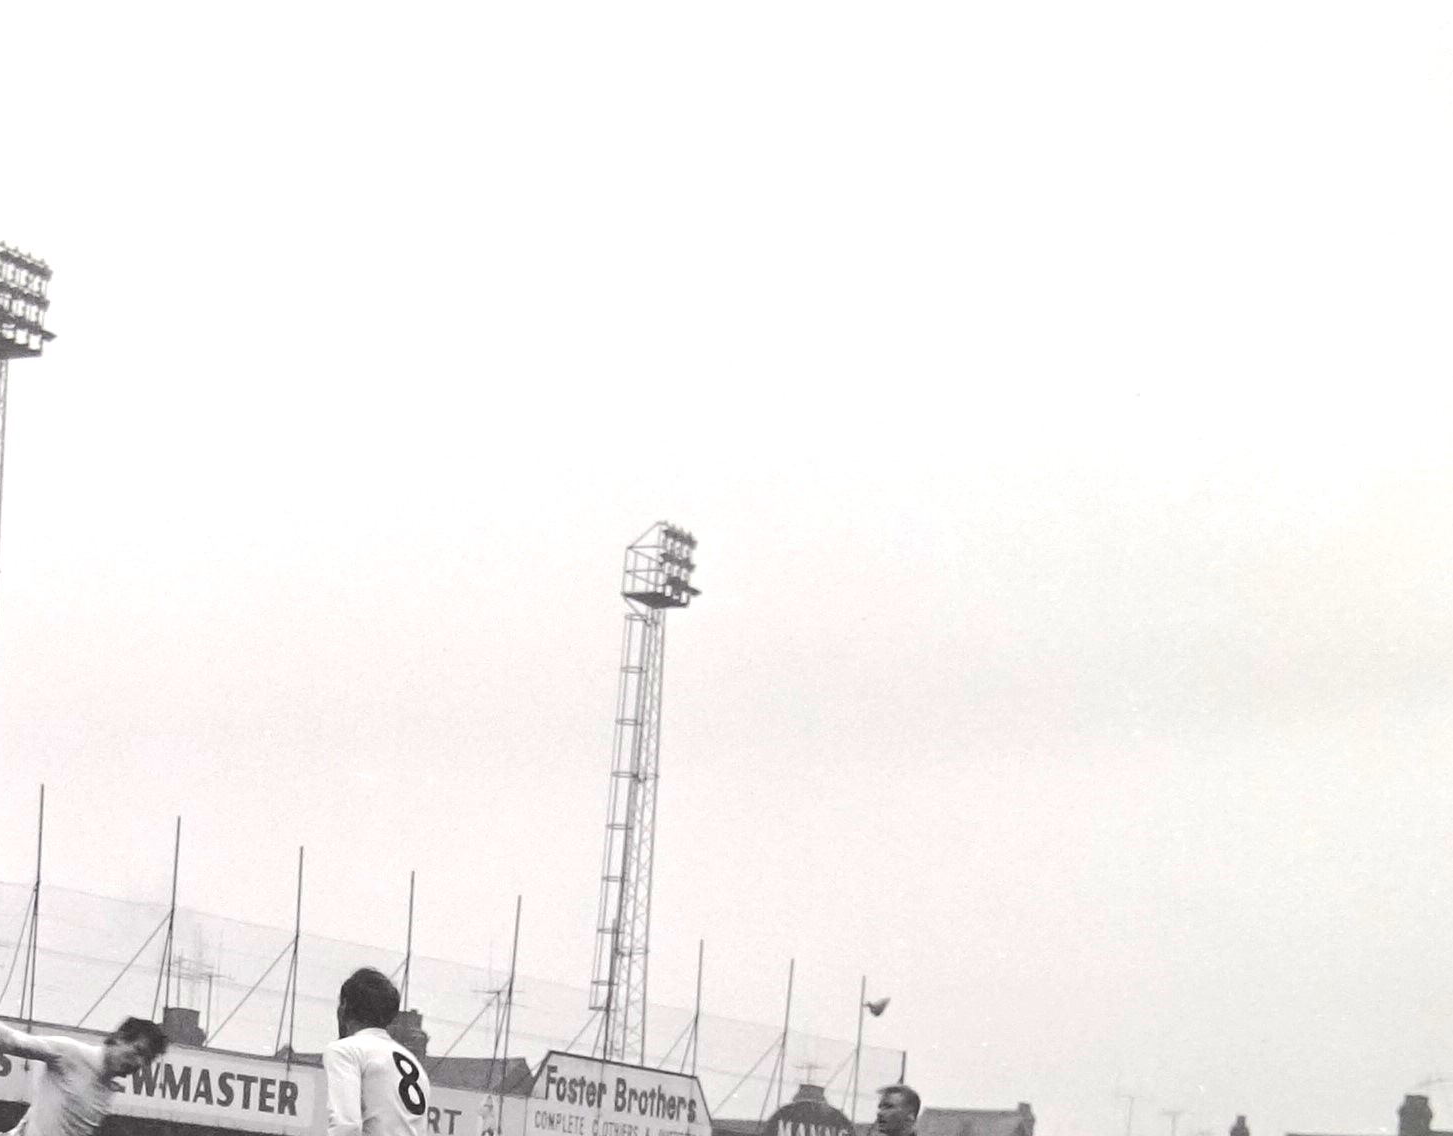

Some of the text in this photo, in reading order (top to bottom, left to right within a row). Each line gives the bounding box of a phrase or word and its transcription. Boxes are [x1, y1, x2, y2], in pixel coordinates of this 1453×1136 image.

[392, 1051, 427, 1116] 8
[545, 1064, 697, 1123] Foster Brothers
[535, 1110, 585, 1136] COMPLETE
